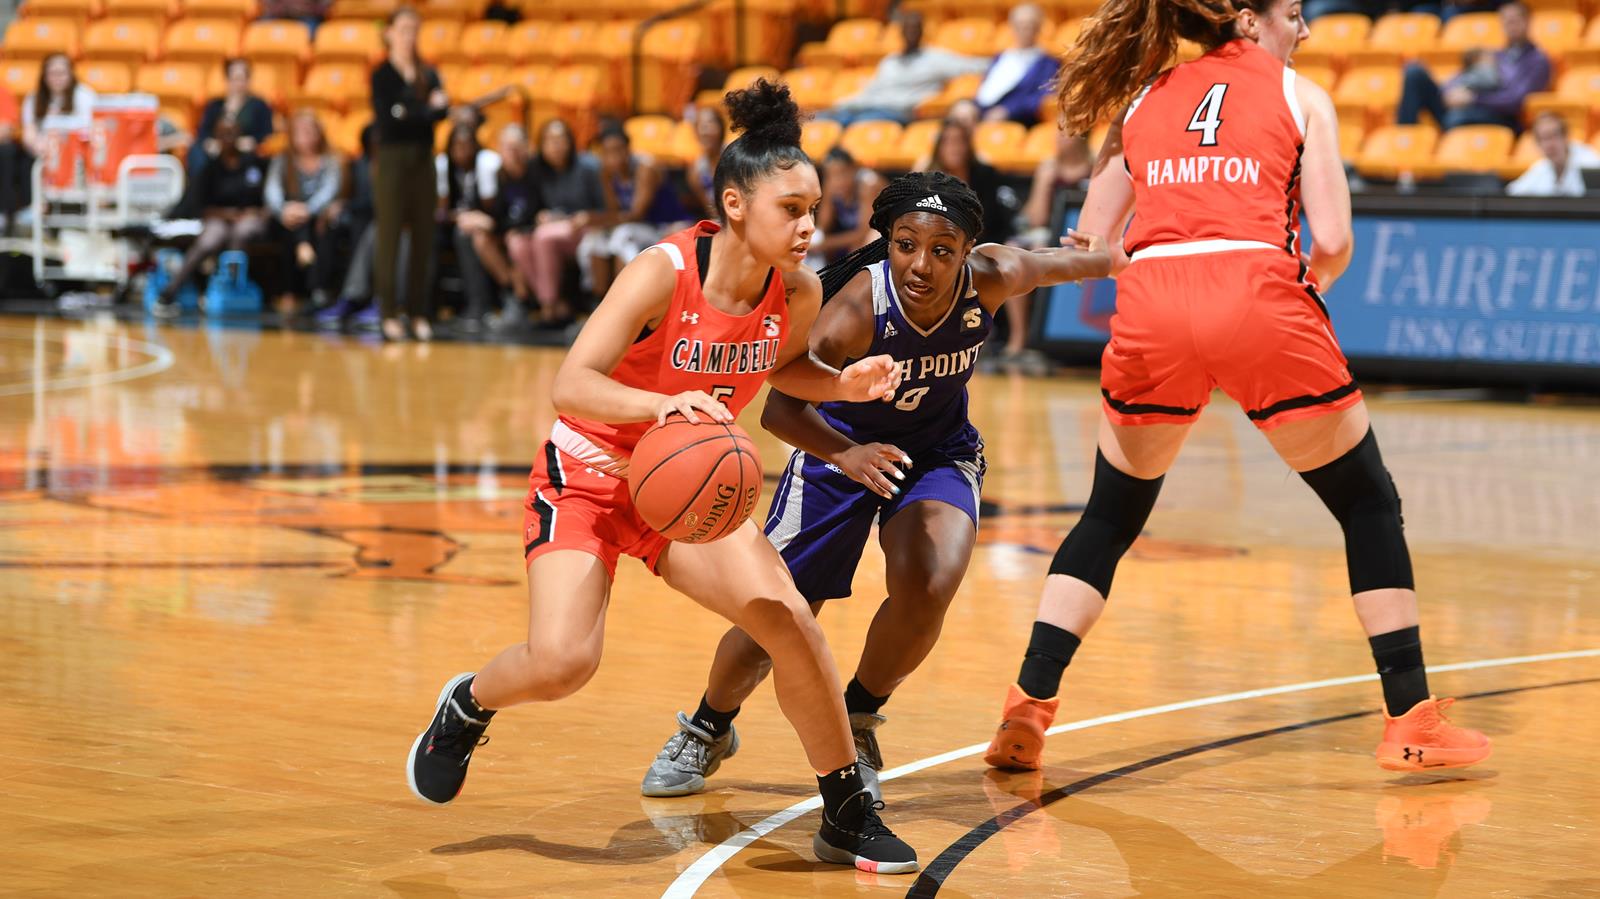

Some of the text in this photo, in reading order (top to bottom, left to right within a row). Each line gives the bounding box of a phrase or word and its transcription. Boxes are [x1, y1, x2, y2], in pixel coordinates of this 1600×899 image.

[1185, 83, 1230, 147] 4
[1147, 156, 1260, 187] HAMPTON
[916, 201, 948, 212] adidas
[671, 337, 780, 374] CAMPBELL
[1386, 315, 1457, 357] INN
[1458, 319, 1488, 359] &
[918, 341, 984, 380] POINT
[895, 386, 930, 412] 0
[674, 484, 736, 542] PALDING
